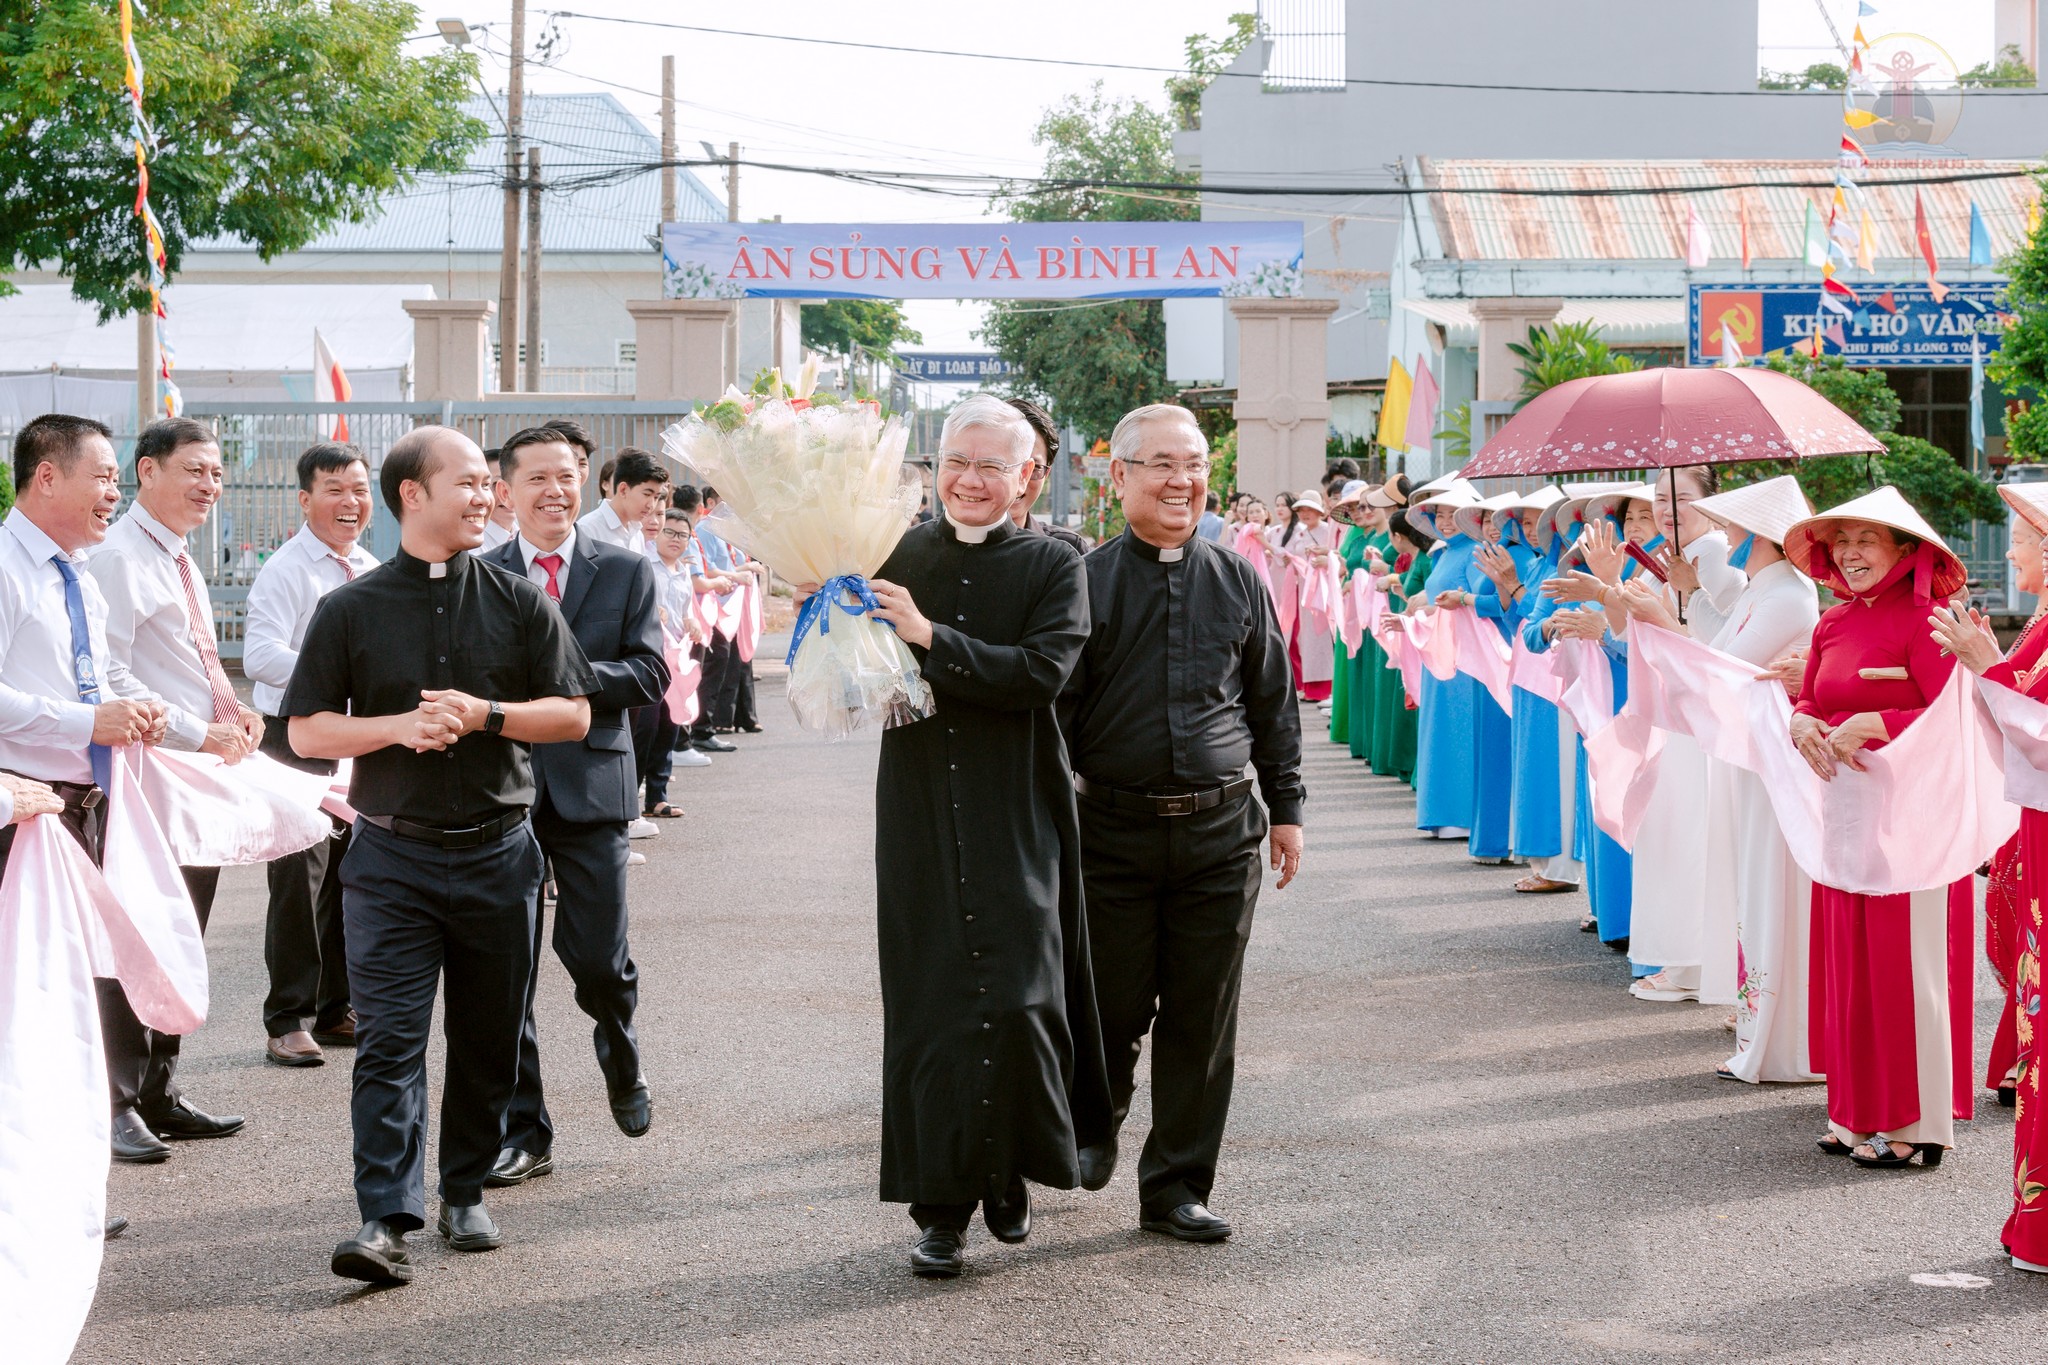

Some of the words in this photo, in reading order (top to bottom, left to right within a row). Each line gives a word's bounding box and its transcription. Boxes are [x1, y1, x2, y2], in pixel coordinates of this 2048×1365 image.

[726, 235, 794, 279] ÂN
[808, 232, 944, 280] SỦNG
[957, 235, 1023, 280] VÀ
[1036, 235, 1157, 279] BÌNH
[1175, 246, 1241, 279] AN
[1917, 307, 1977, 336] VĂN
[1840, 342, 1869, 354] KHU
[1871, 339, 1900, 354] PHỐ
[1902, 342, 1911, 354] 3
[1913, 342, 1949, 354] LONG
[945, 360, 975, 375] LOAN
[979, 357, 1001, 375] BÁO
